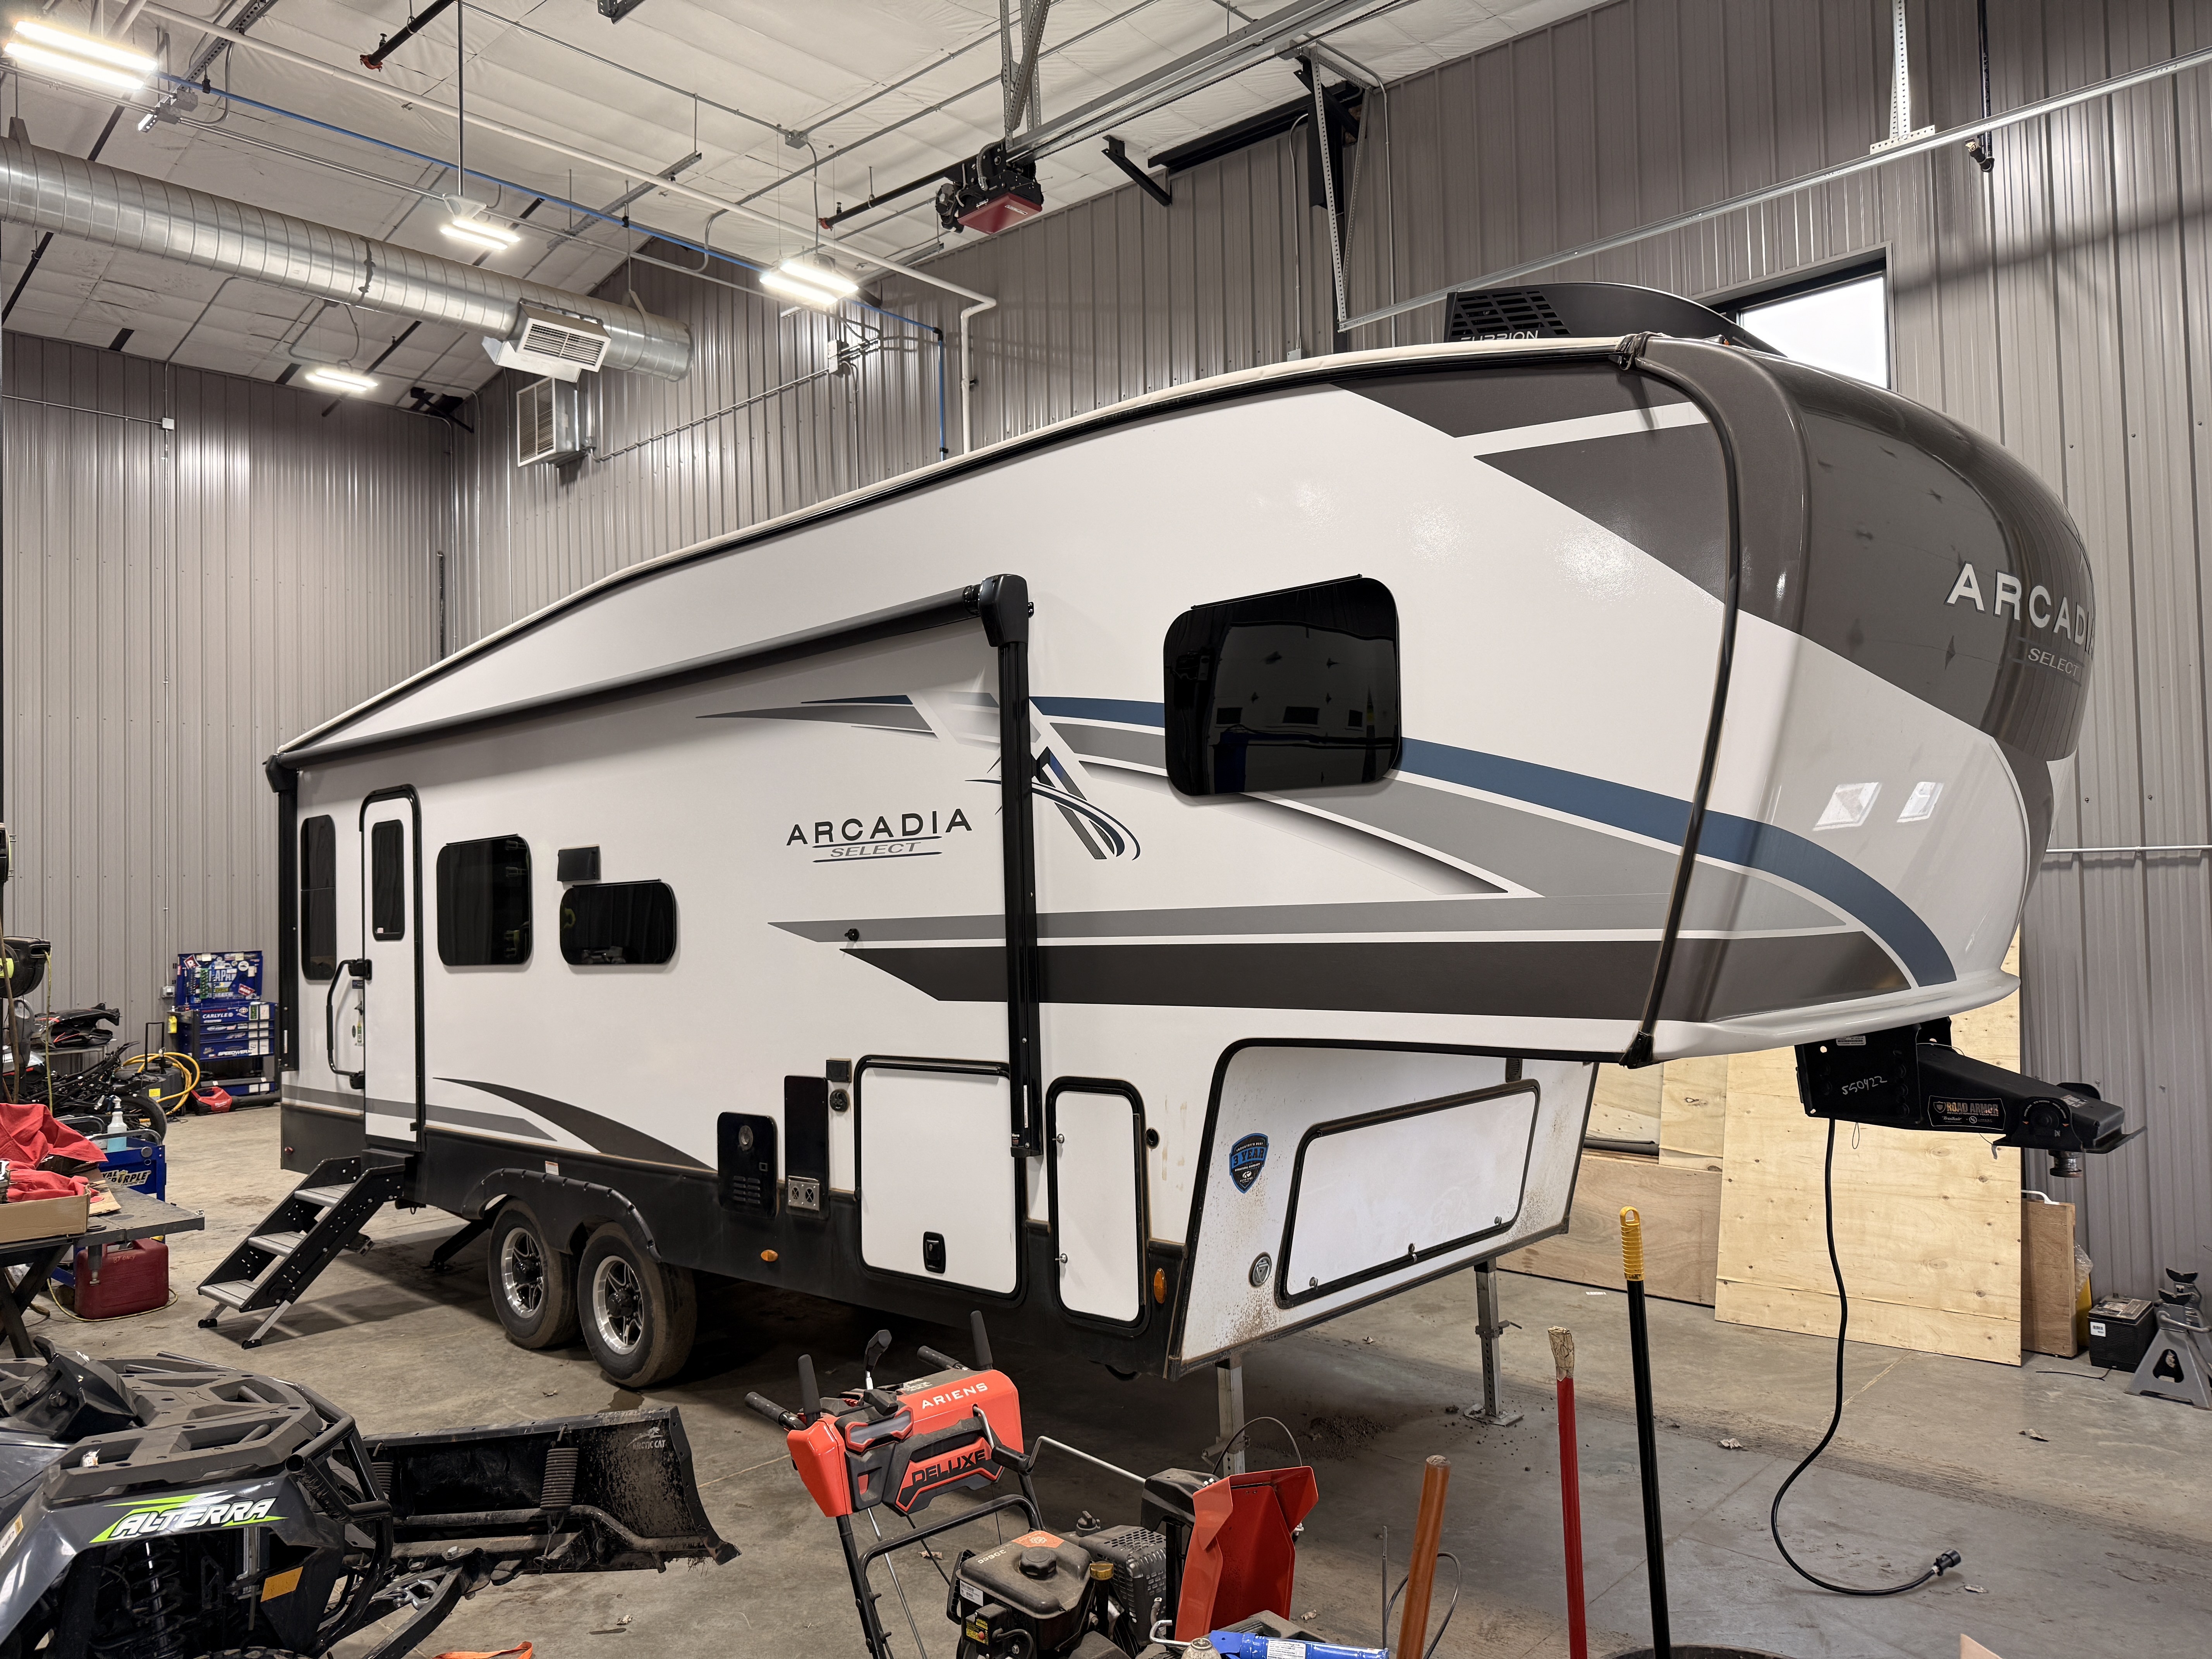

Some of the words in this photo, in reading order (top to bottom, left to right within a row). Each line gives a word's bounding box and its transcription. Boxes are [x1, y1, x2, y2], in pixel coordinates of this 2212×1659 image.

[2028, 648, 2080, 677] SELECT
[786, 808, 972, 846] ARCADIA
[830, 842, 921, 857] SELECT
[209, 970, 231, 982] APA
[1842, 1076, 1887, 1095] 550422
[1946, 1102, 1968, 1113] ROAD
[1970, 1103, 1999, 1114] ARMOR
[1233, 1155, 1239, 1166] 3
[1242, 1147, 1265, 1161] YEAR
[921, 1382, 988, 1409] ARIENS
[654, 1439, 666, 1448] CAT
[911, 1449, 987, 1487] DELUXE
[110, 1497, 277, 1538] ALTERRA
